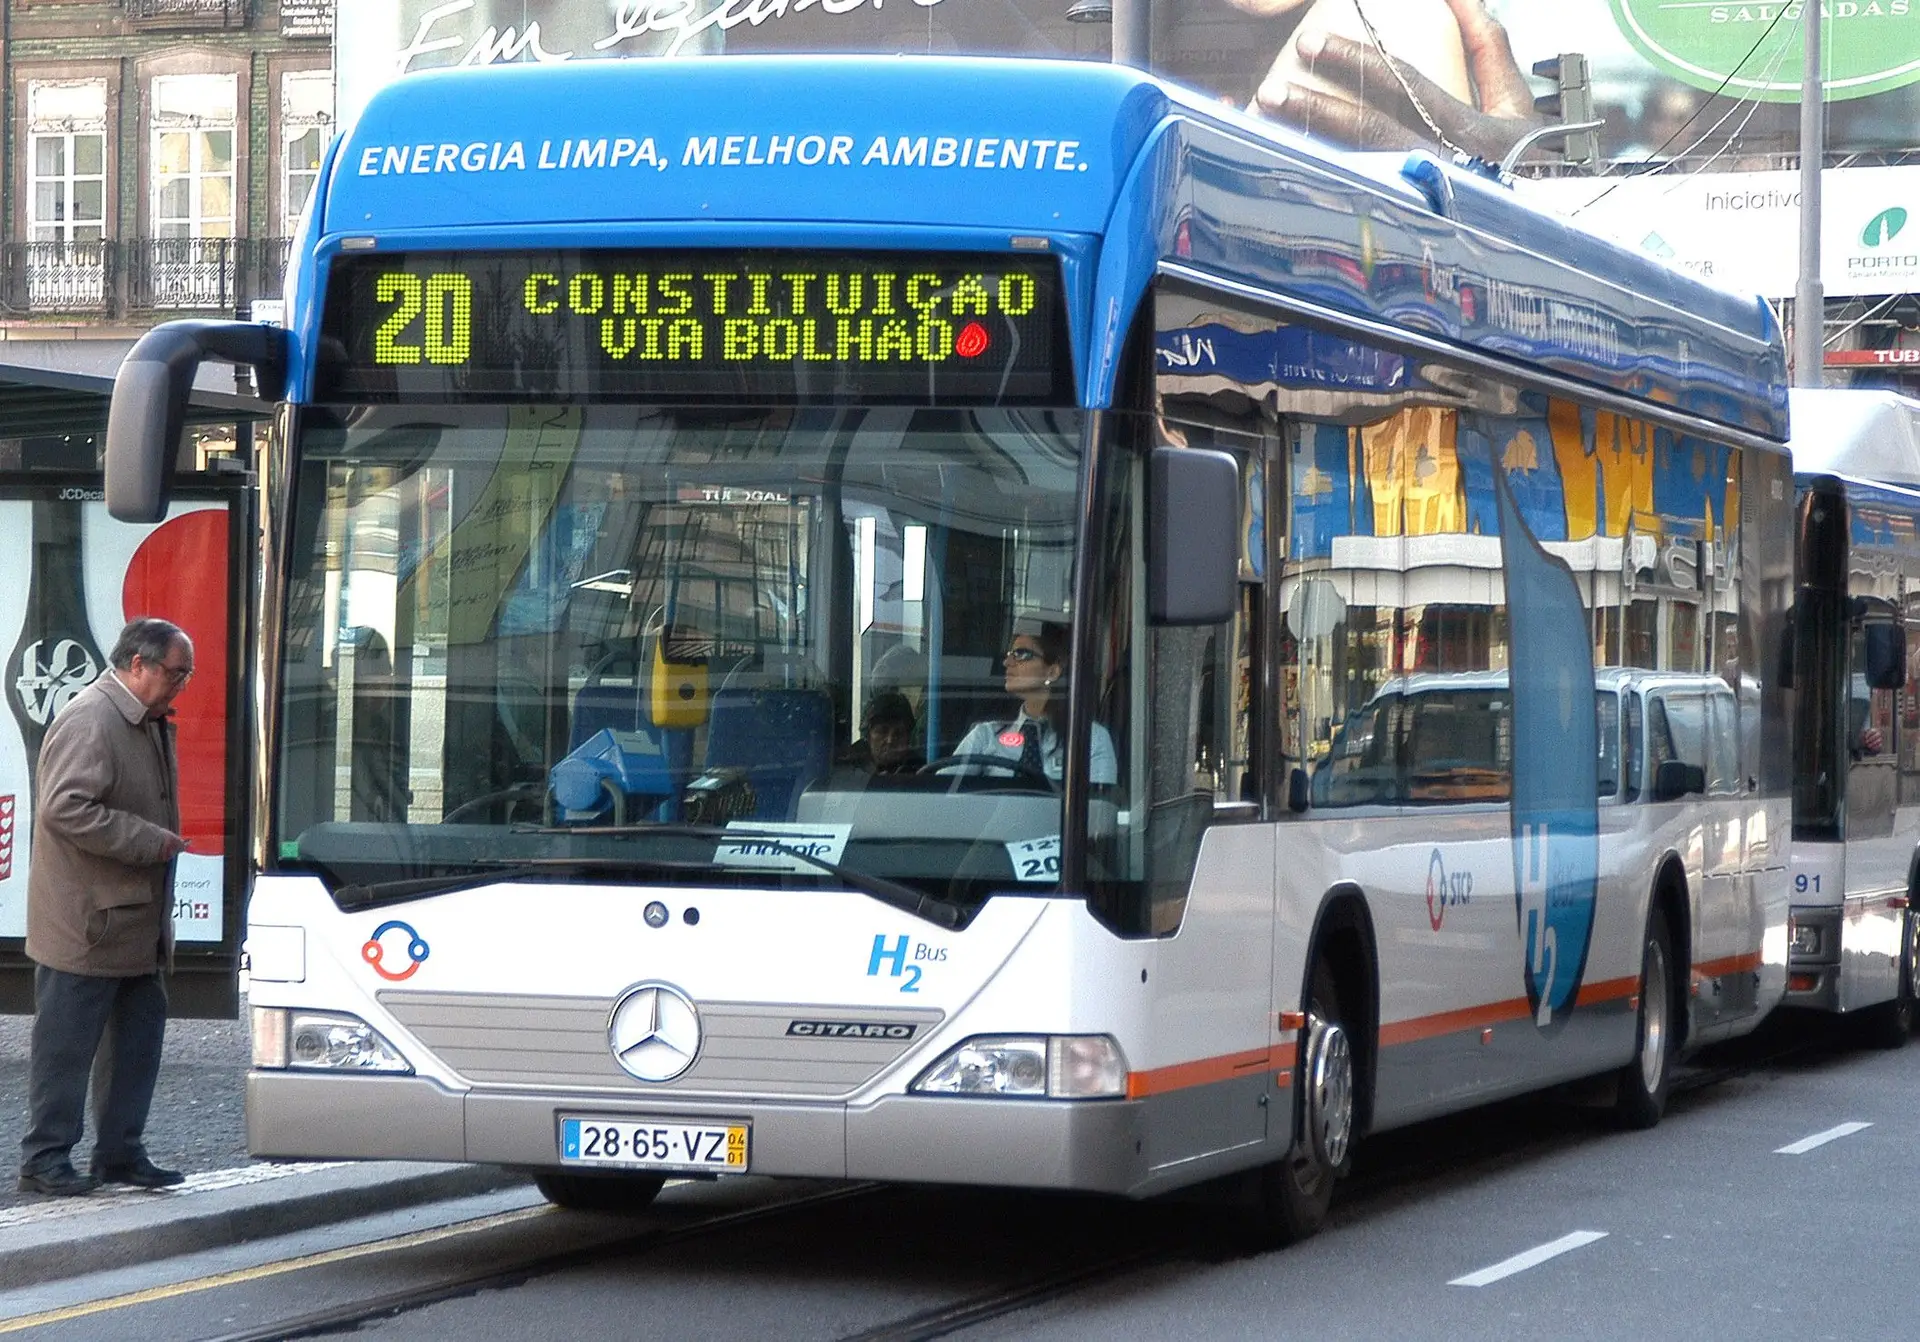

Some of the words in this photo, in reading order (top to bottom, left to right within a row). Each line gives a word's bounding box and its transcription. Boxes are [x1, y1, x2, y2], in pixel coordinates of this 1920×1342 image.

[358, 141, 526, 177] ENERGIA
[537, 137, 669, 172] LIMPA,
[681, 135, 855, 166] MELHOR
[861, 137, 1089, 172] AMBIENTE.
[1848, 255, 1918, 268] PORTO
[375, 273, 472, 364] 20
[601, 318, 703, 360] VIA
[1874, 350, 1920, 362] TUB
[1021, 855, 1060, 878] 20
[1451, 871, 1473, 907] STCP
[1795, 874, 1820, 893] 91
[914, 943, 948, 961] Bus
[792, 1023, 910, 1038] CITARO
[728, 1133, 745, 1145] 04
[727, 1152, 744, 1164] 01
